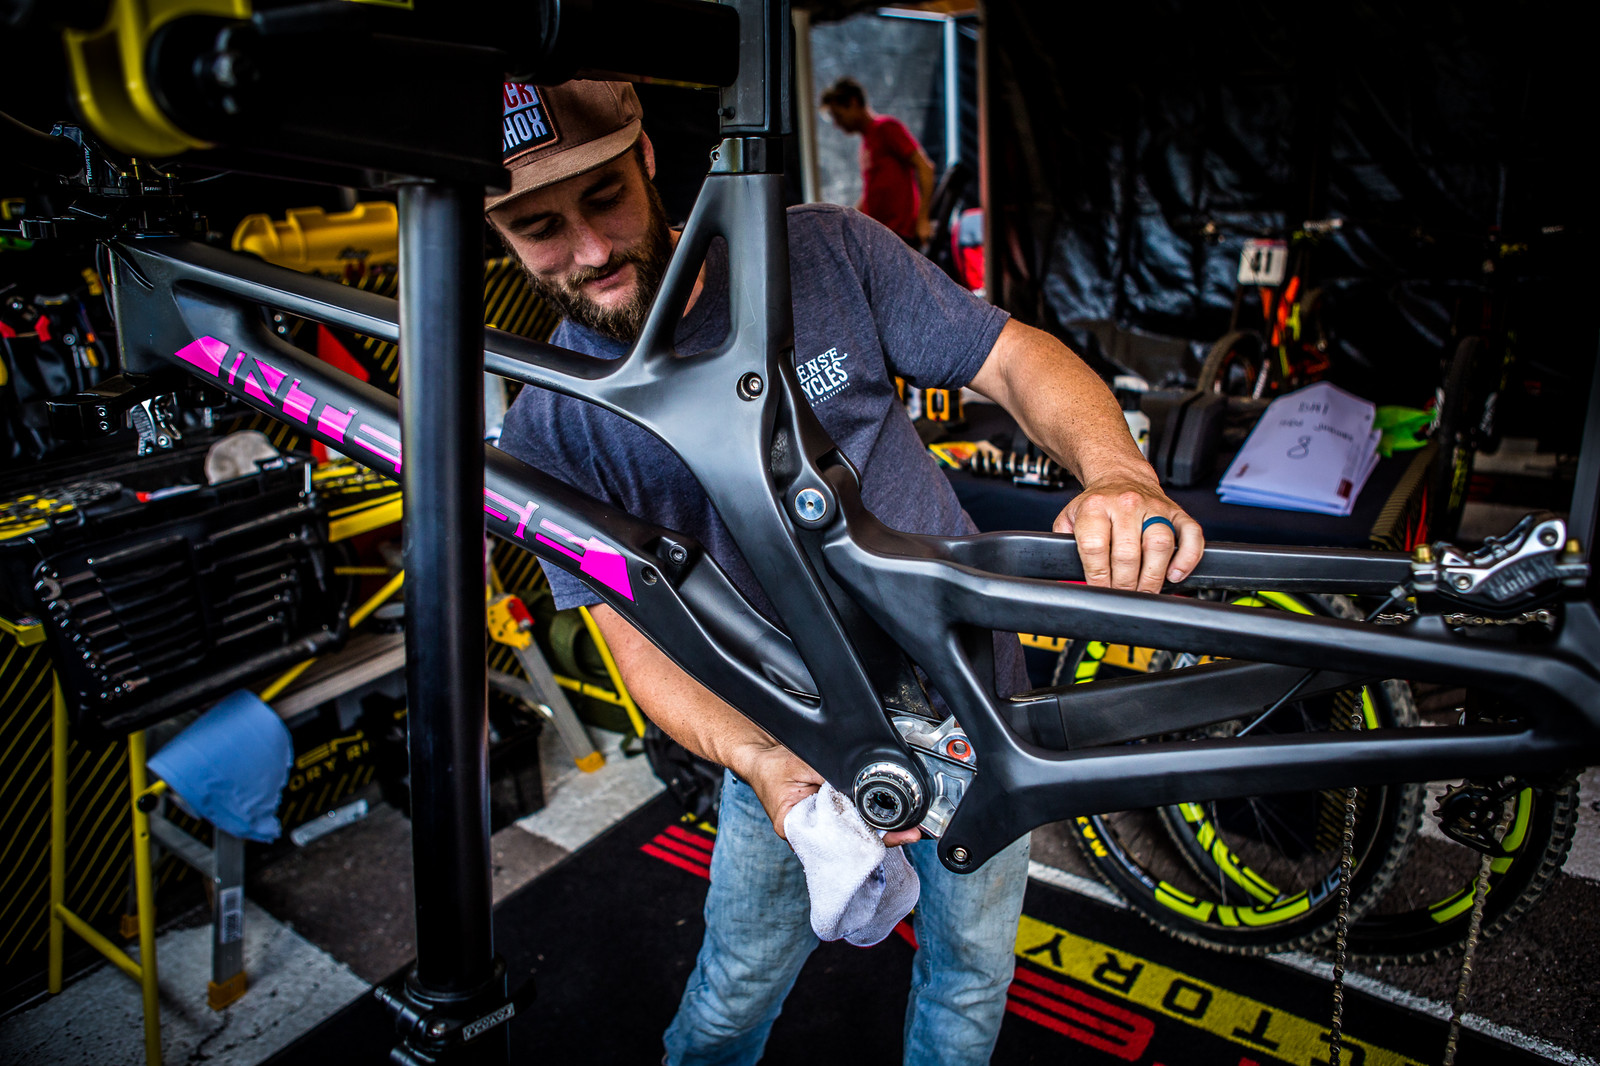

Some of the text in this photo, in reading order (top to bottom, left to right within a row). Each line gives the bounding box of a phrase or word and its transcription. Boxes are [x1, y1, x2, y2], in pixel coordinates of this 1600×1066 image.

[503, 82, 535, 109] CK
[503, 107, 548, 152] HOX
[1250, 250, 1272, 273] 41
[796, 347, 848, 385] ENSE
[801, 360, 849, 400] YCLES
[1023, 932, 1367, 1066] CTORY
